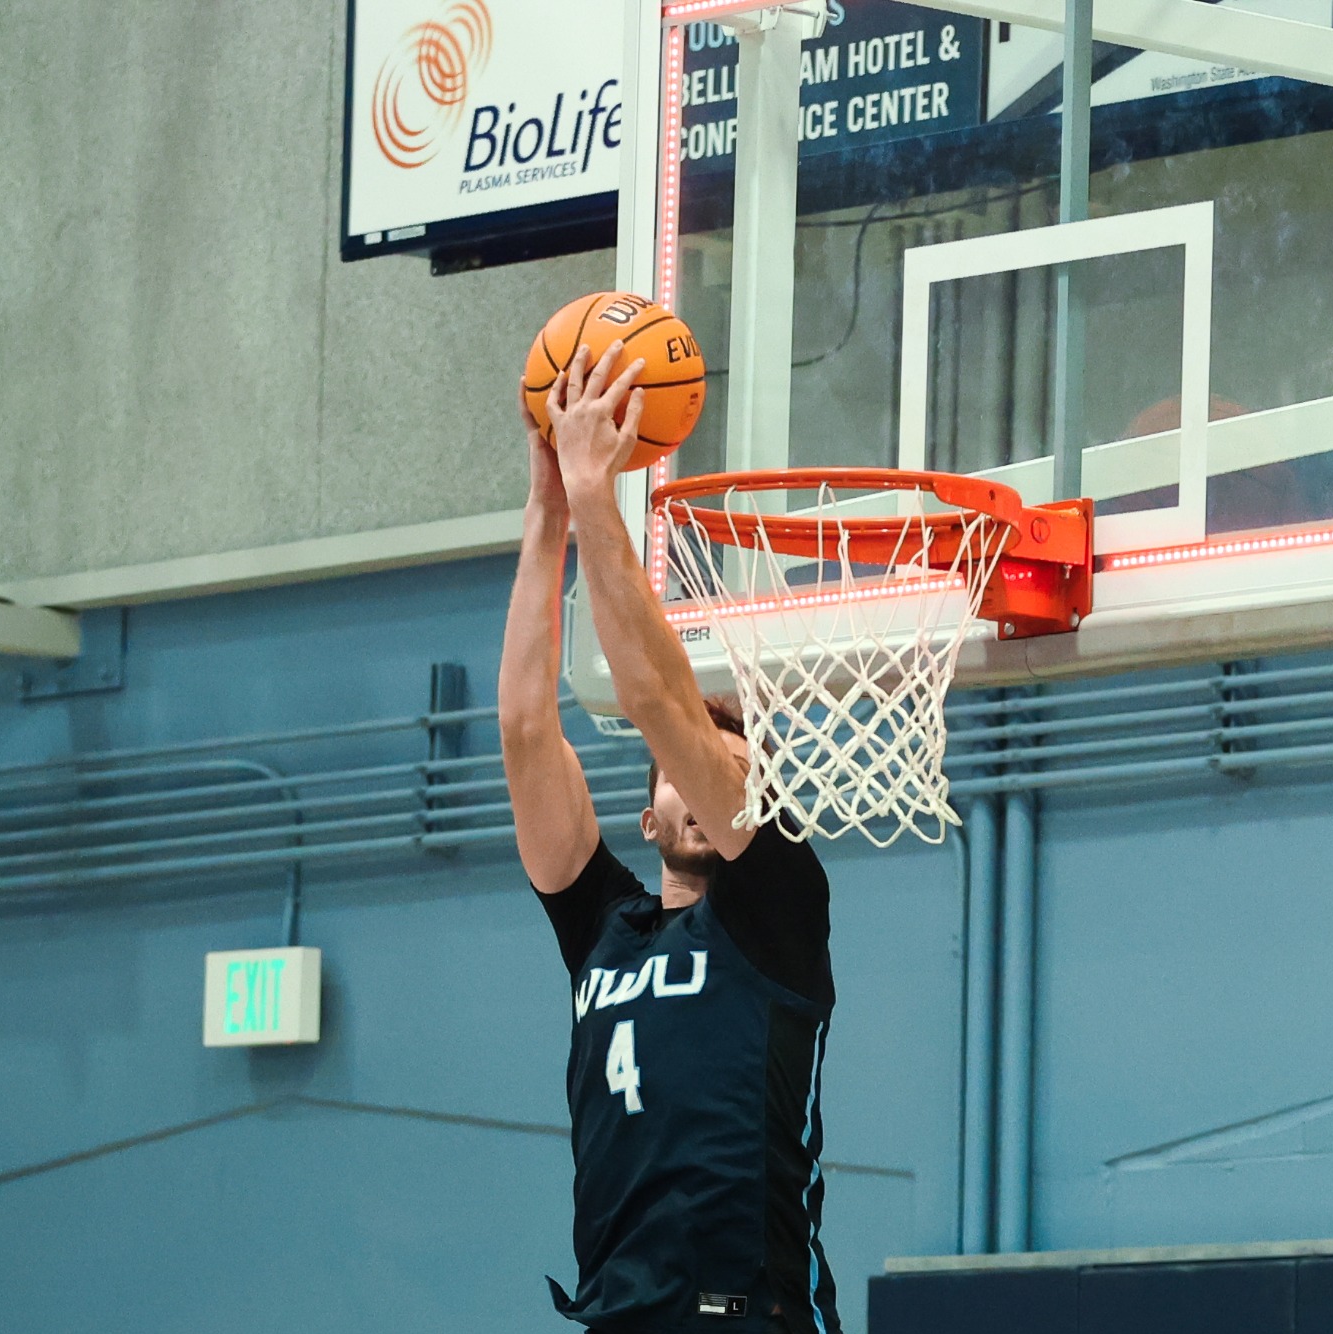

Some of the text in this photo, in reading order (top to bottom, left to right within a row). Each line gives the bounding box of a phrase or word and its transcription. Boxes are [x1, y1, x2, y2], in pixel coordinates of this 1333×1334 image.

[681, 24, 962, 108] BELLIAM HOTEL &
[462, 78, 623, 174] BioLife
[846, 81, 951, 134] CENTER
[458, 160, 578, 195] PLASMA SERVICES
[223, 958, 286, 1035] EXIT
[574, 949, 709, 1024] WWU
[605, 1018, 646, 1117] 4
